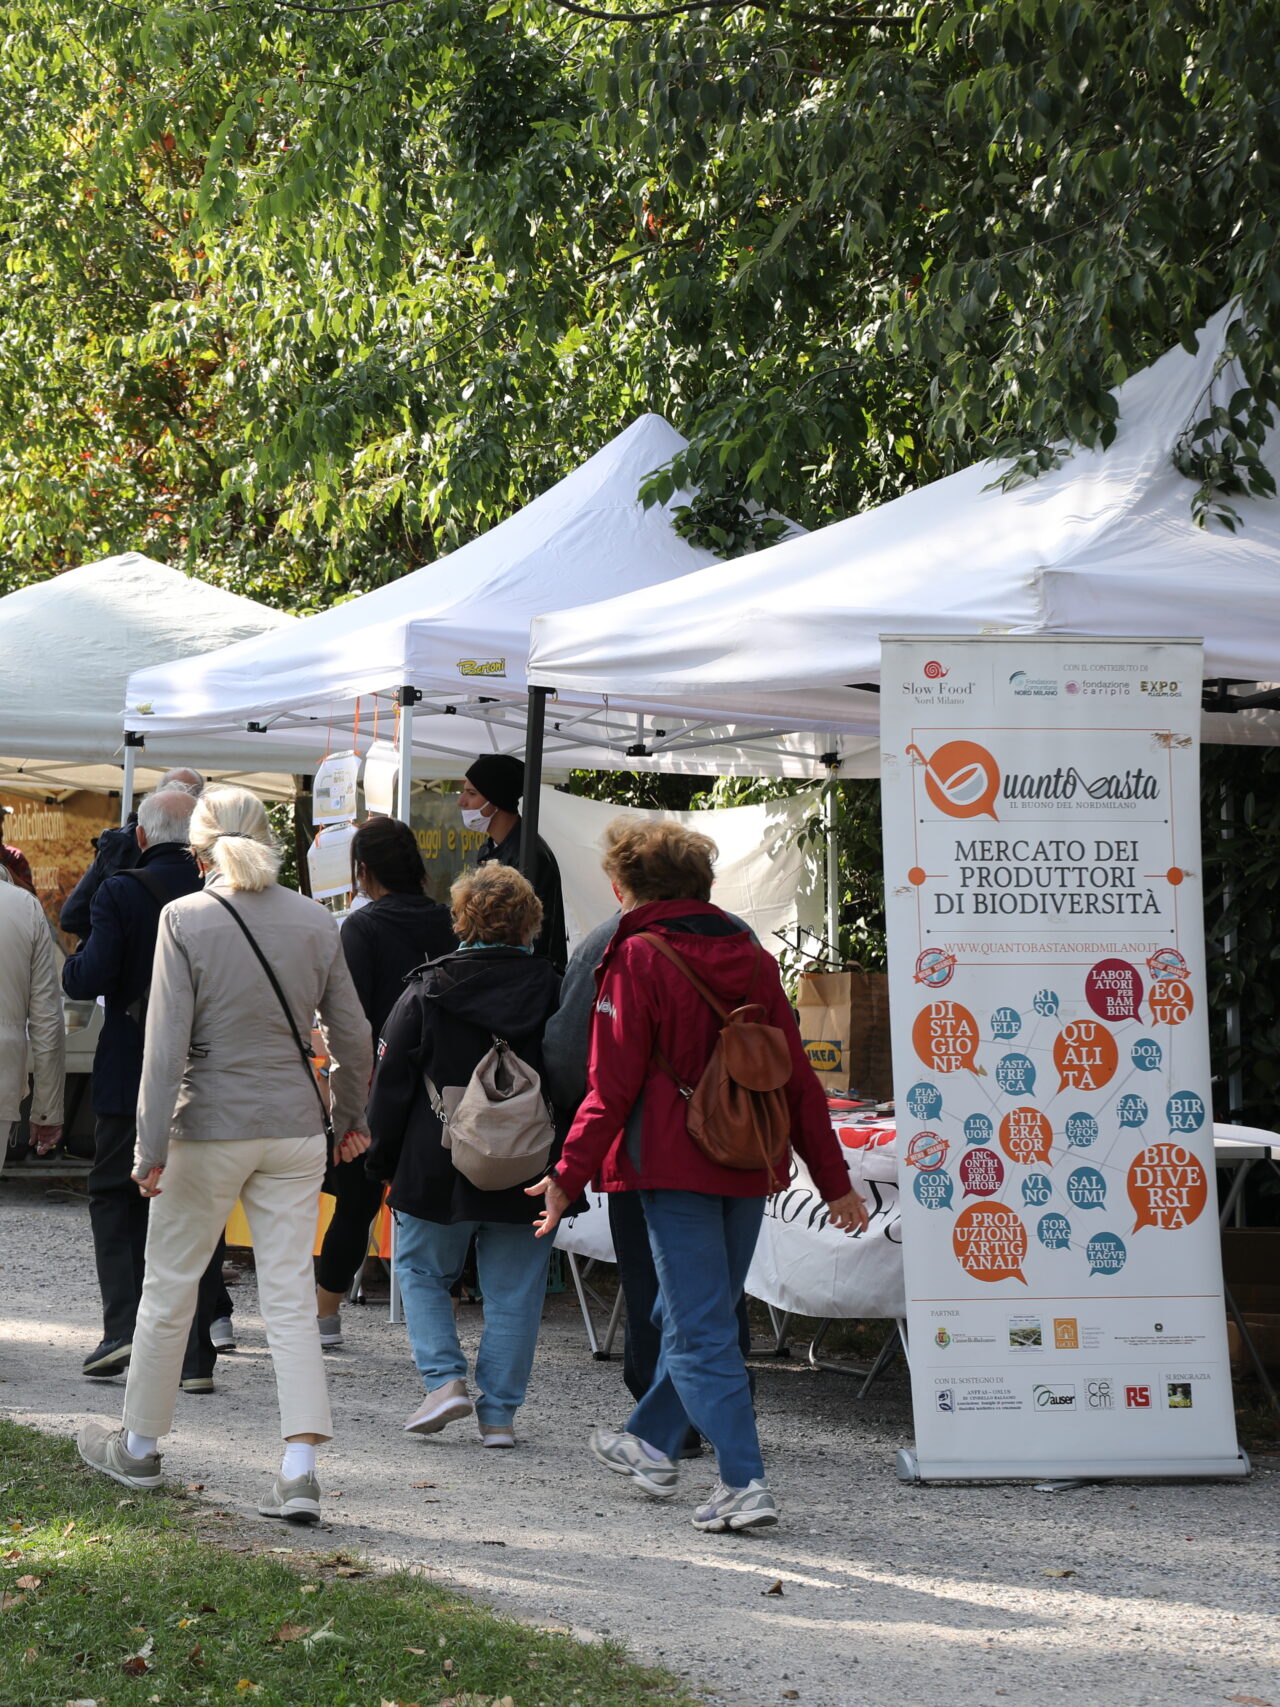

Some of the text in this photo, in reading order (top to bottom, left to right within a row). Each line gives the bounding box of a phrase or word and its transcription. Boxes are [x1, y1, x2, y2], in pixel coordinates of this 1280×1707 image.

[456, 658, 505, 675] Bertoni
[1063, 664, 1149, 672] CON IL CONTRIBUTO DI
[902, 681, 934, 695] Slow
[1082, 680, 1130, 688] fondazione
[1140, 680, 1178, 693] EXPO
[1033, 689, 1058, 697] MILANO
[914, 696, 965, 705] Nord Milano
[955, 840, 1139, 862] MERCATO DEI
[960, 866, 1136, 888] PRODUTTORI
[934, 888, 1162, 914] DI BIODIVERSITÀ
[944, 942, 1160, 954] WWW.QUANTOBASTANORDMILANO.IT
[1092, 970, 1133, 980] LABOR
[1094, 979, 1133, 989] ATORI
[1035, 989, 1054, 1002] RI
[1117, 989, 1133, 997] PER
[1153, 982, 1186, 1005] EQ
[1106, 997, 1134, 1006] BAM
[930, 1001, 955, 1018] DI
[992, 1009, 1012, 1022] MI
[1035, 1003, 1057, 1016] SO
[1106, 1006, 1134, 1016] BINI
[1154, 1005, 1190, 1023] UO
[930, 1019, 974, 1036] STA
[1061, 1023, 1097, 1046] QU
[931, 1037, 972, 1054] GIO
[1130, 1045, 1160, 1057] DOL
[807, 1049, 837, 1062] IKEA
[1061, 1047, 1103, 1065] ALI
[931, 1055, 964, 1072] NE
[998, 1060, 1032, 1069] PASTA
[1145, 1057, 1161, 1068] CI
[997, 1069, 1025, 1080] FRE
[1063, 1065, 1097, 1088] TÀ
[998, 1080, 1027, 1091] SCA
[915, 1088, 940, 1096] PIAN
[907, 1102, 926, 1112] FIO
[1117, 1098, 1147, 1110] FAR
[1170, 1099, 1204, 1114] BIR
[917, 1111, 928, 1120] RI
[1008, 1109, 1043, 1126] FILI
[1117, 1110, 1146, 1122] INA
[1170, 1114, 1199, 1129] RA
[970, 1119, 989, 1130] LIQ
[1068, 1119, 1097, 1128] PANE
[966, 1129, 993, 1139] UORI
[1008, 1126, 1044, 1139] ERA
[1009, 1138, 1044, 1151] COR
[1068, 1136, 1097, 1145] ACCE
[971, 1151, 991, 1160] INC
[1015, 1152, 1038, 1165] TA
[1141, 1145, 1191, 1166] BIO
[964, 1159, 999, 1168] ONTRI
[919, 1175, 950, 1186] CON
[968, 1173, 997, 1182] PROD
[1025, 1175, 1044, 1189] VI
[1069, 1176, 1101, 1189] SAL
[1133, 1166, 1201, 1187] DIVE
[920, 1187, 946, 1198] SER
[1025, 1190, 1051, 1202] NO
[1070, 1189, 1105, 1203] UMI
[1147, 1187, 1191, 1208] RSI
[920, 1199, 940, 1209] VE
[971, 1212, 1022, 1227] PROD
[1042, 1219, 1067, 1229] FOR
[955, 1227, 1023, 1241] UZIONI
[1042, 1229, 1071, 1239] MAG
[965, 1241, 1023, 1256] ARTIG
[1043, 1240, 1057, 1249] GI
[1088, 1242, 1116, 1251] FRUT
[1088, 1250, 1125, 1260] TA&VE
[958, 1255, 1024, 1270] IANALI
[1089, 1259, 1125, 1268] RDURA
[934, 1377, 950, 1385] CON
[959, 1376, 995, 1384] SOSTEGNO
[996, 1376, 1004, 1384] DI
[1049, 1395, 1075, 1405] auser
[1125, 1387, 1150, 1407] RS
